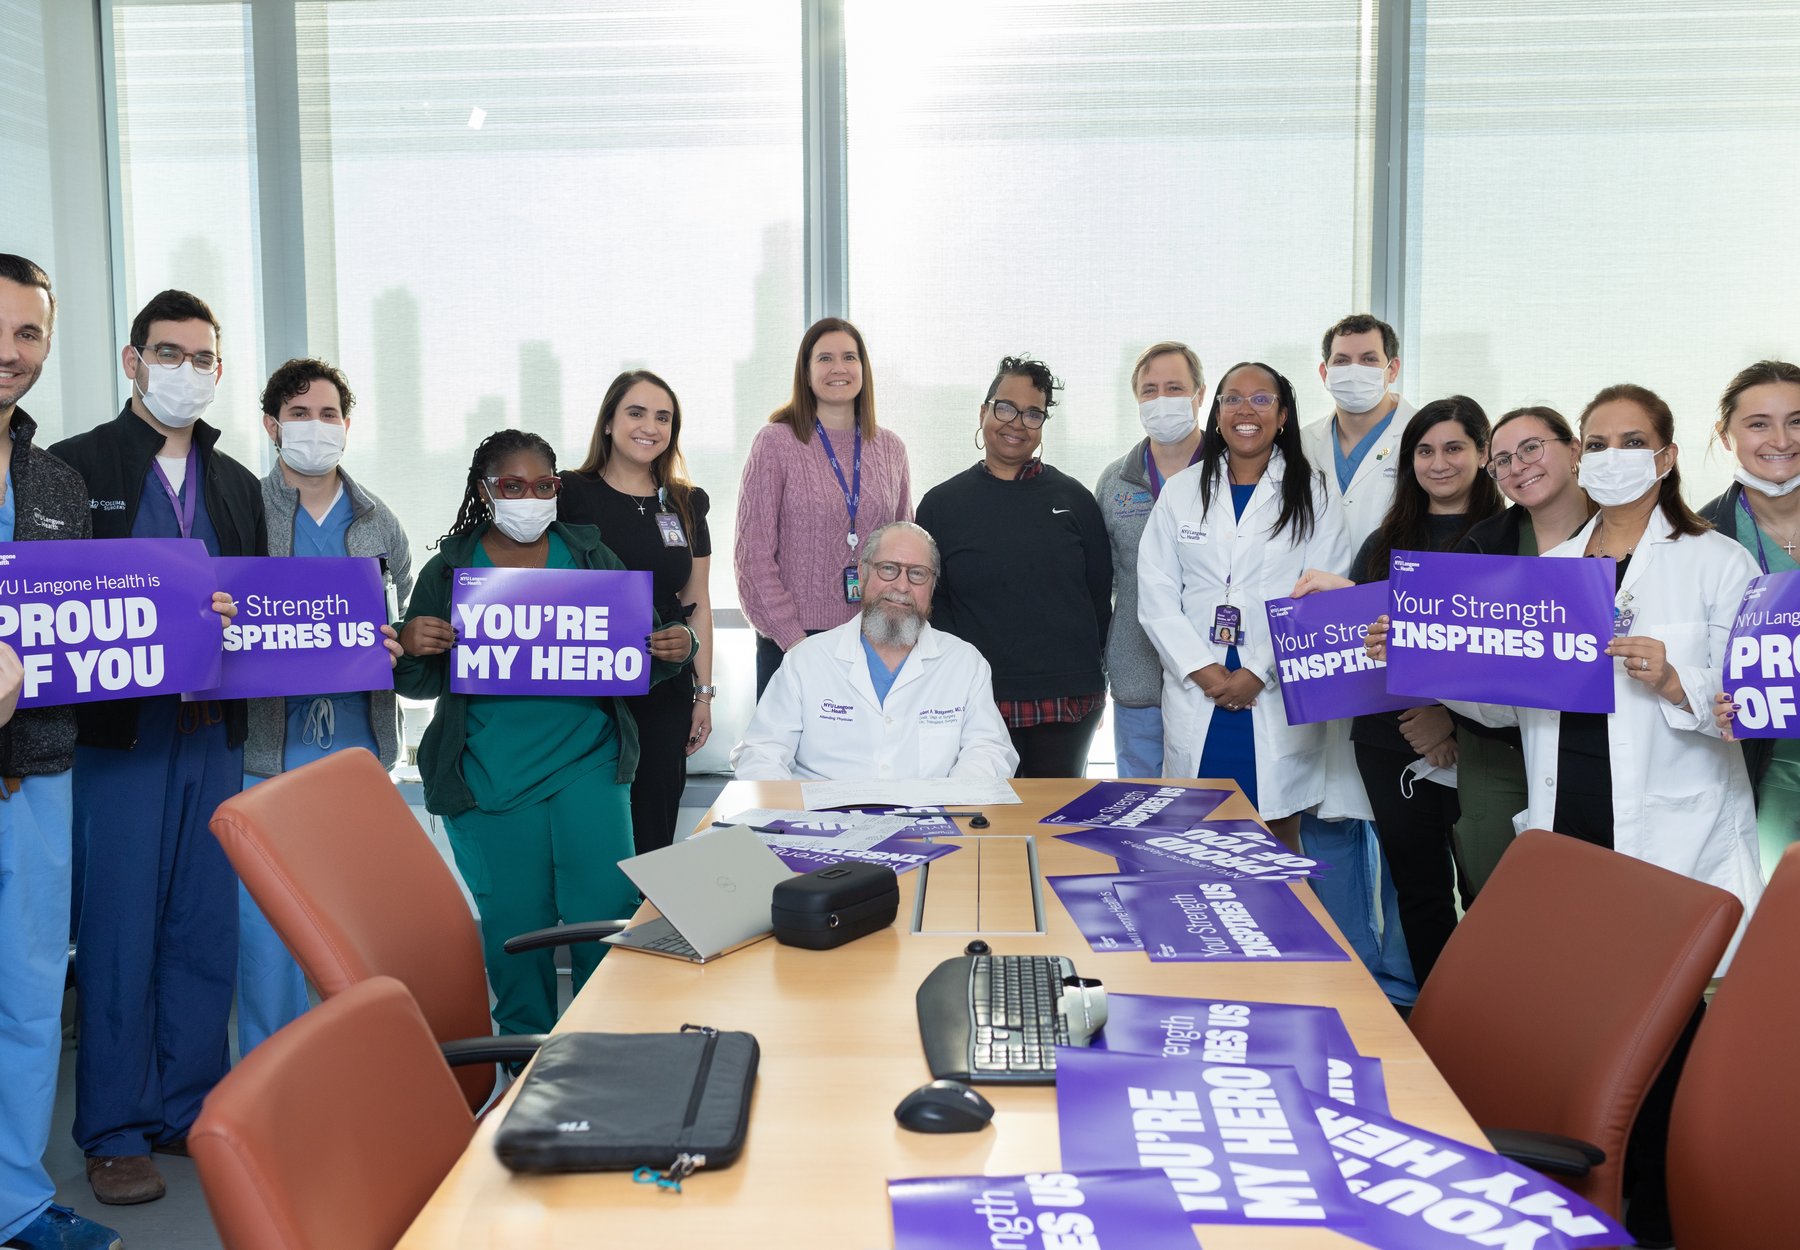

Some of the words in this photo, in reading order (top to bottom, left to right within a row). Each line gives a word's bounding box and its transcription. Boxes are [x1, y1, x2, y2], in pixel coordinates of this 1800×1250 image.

[0, 579, 19, 595] YU
[24, 578, 92, 596] Langone
[95, 574, 145, 590] Health
[148, 573, 161, 587] is
[246, 594, 349, 621] Strength
[457, 604, 609, 641] YOU'RE
[1393, 590, 1444, 615] Your
[1451, 594, 1566, 627] Strength
[1735, 611, 1763, 628] NYU
[1766, 611, 1800, 627] Lang
[221, 621, 332, 652] SPIRES
[338, 621, 376, 648] US
[1275, 632, 1318, 653] Your
[1324, 623, 1377, 645] Stre
[1392, 620, 1545, 659] INSPIRES
[1552, 632, 1598, 662] US
[23, 653, 53, 699] F
[65, 644, 165, 694] YOU
[457, 645, 520, 680] MY
[531, 646, 643, 681] HERO
[1280, 646, 1387, 683] INSPIR
[1733, 686, 1797, 730] OF
[1100, 790, 1148, 814] Strength
[1109, 797, 1174, 828] INSPIRES
[1154, 787, 1186, 798] US
[1145, 837, 1285, 875] PROUD
[1174, 829, 1260, 854] YOU
[1247, 852, 1317, 868] OF
[1199, 883, 1237, 899] US
[1169, 893, 1217, 934] Strength
[1209, 900, 1282, 957] INSPIRES
[1200, 934, 1233, 957] Your
[1207, 1003, 1251, 1028] US
[1160, 1015, 1202, 1057] ength
[1202, 1066, 1300, 1154] HERO
[1024, 1173, 1086, 1208] US
[1229, 1161, 1327, 1219] MY
[1450, 1171, 1610, 1238] MY
